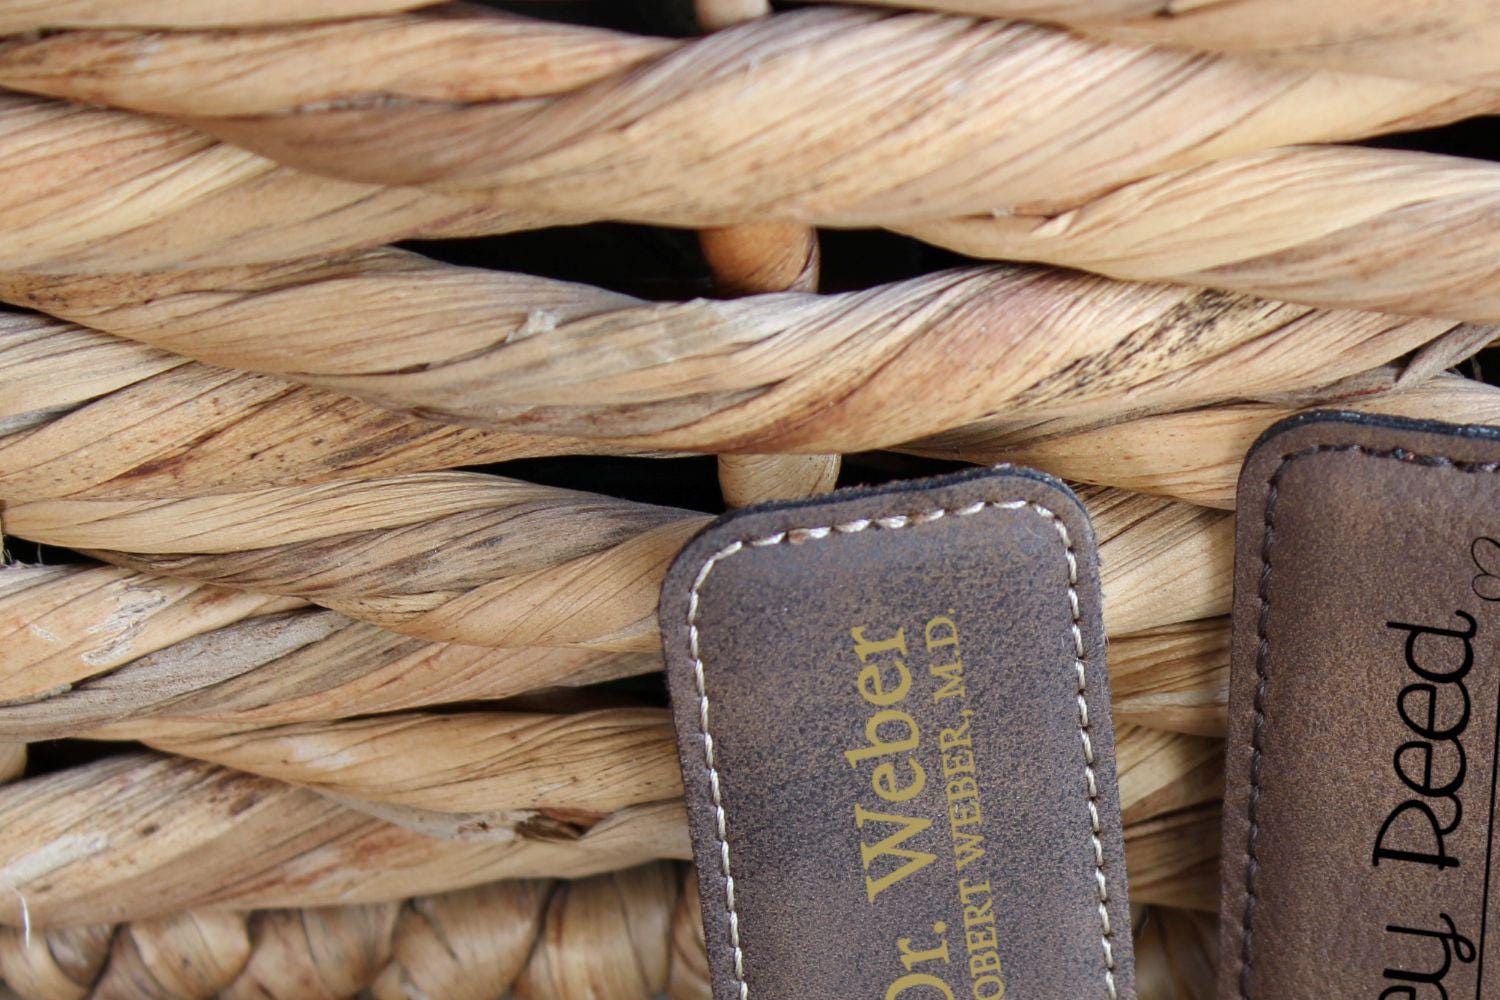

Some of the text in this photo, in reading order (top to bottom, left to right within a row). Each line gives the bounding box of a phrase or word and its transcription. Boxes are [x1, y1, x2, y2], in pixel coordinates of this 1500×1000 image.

[924, 607, 966, 705] M.D.
[1372, 609, 1477, 870] Reed
[844, 625, 938, 902] Weber
[939, 708, 987, 870] WEBER,
